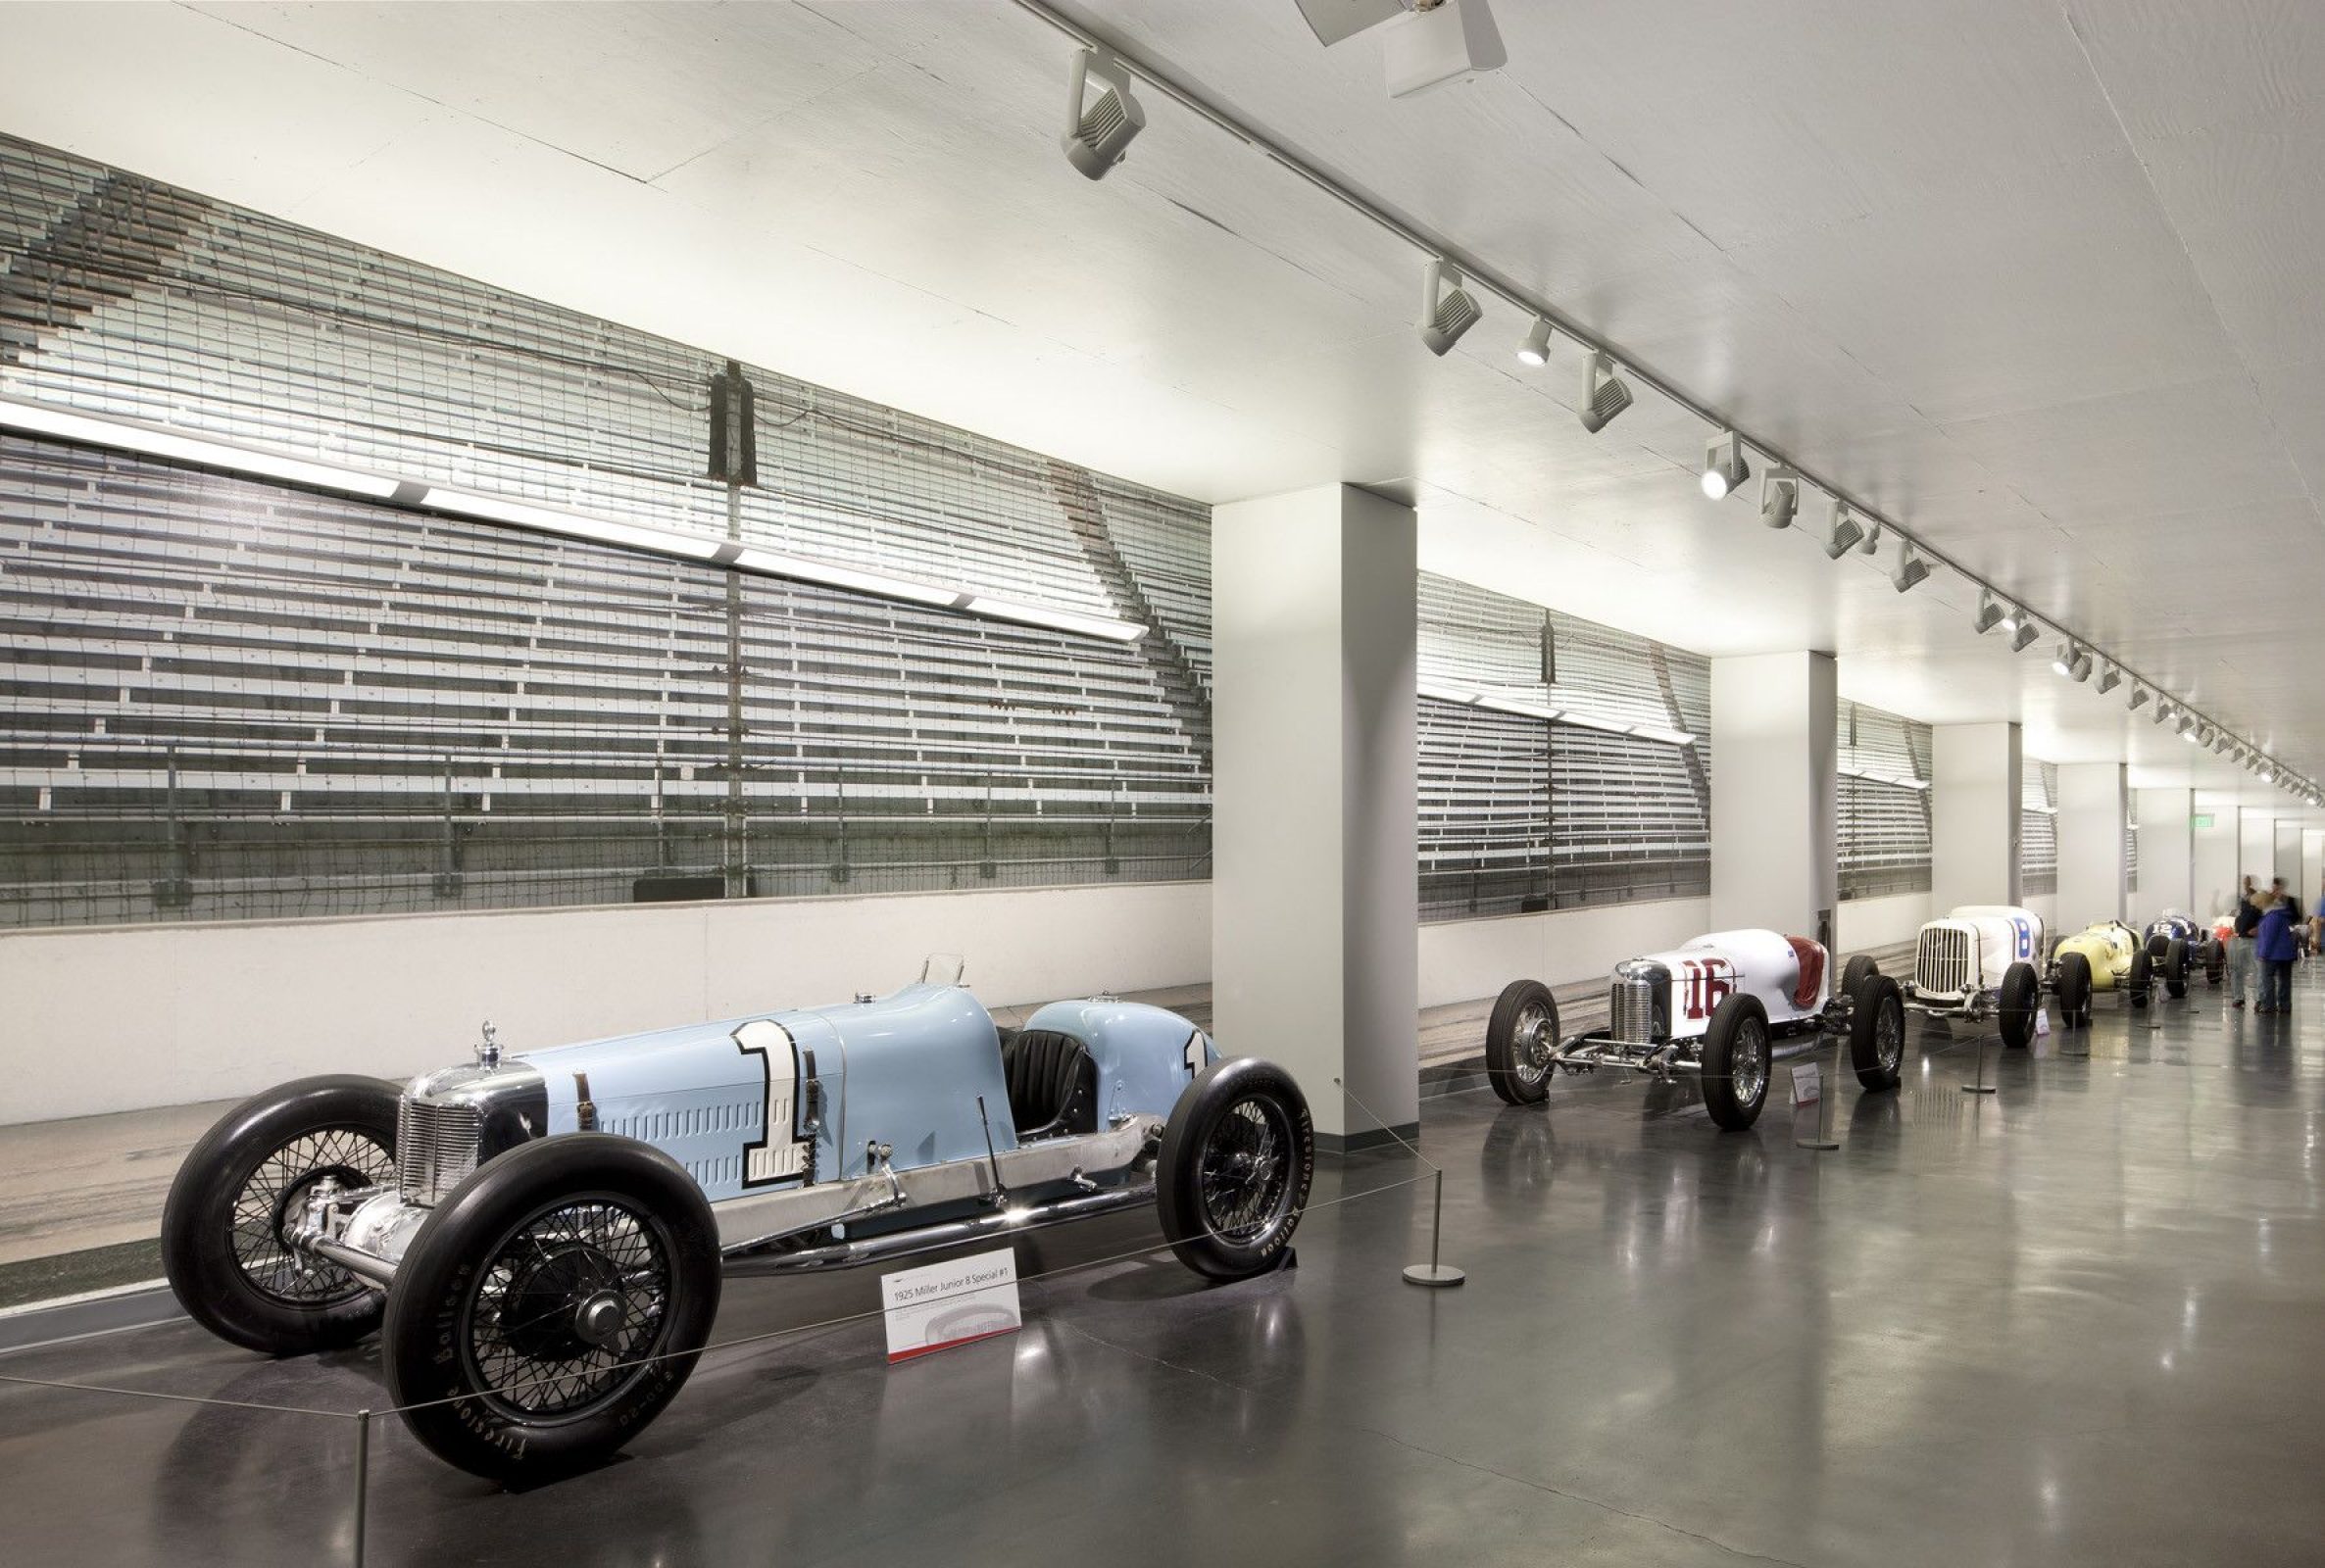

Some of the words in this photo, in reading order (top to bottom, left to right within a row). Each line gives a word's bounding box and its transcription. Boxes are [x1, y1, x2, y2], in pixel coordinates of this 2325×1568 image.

[2015, 918, 2030, 957] 8
[1681, 957, 1730, 1019] 16
[729, 1019, 816, 1190] 1
[894, 1288, 915, 1302] 1925
[915, 1283, 939, 1297] Miller
[940, 1278, 965, 1292] Junior
[965, 1275, 970, 1286] 8
[972, 1268, 998, 1284] Special
[1000, 1267, 1009, 1278] #1
[447, 1387, 526, 1459] Firestone
